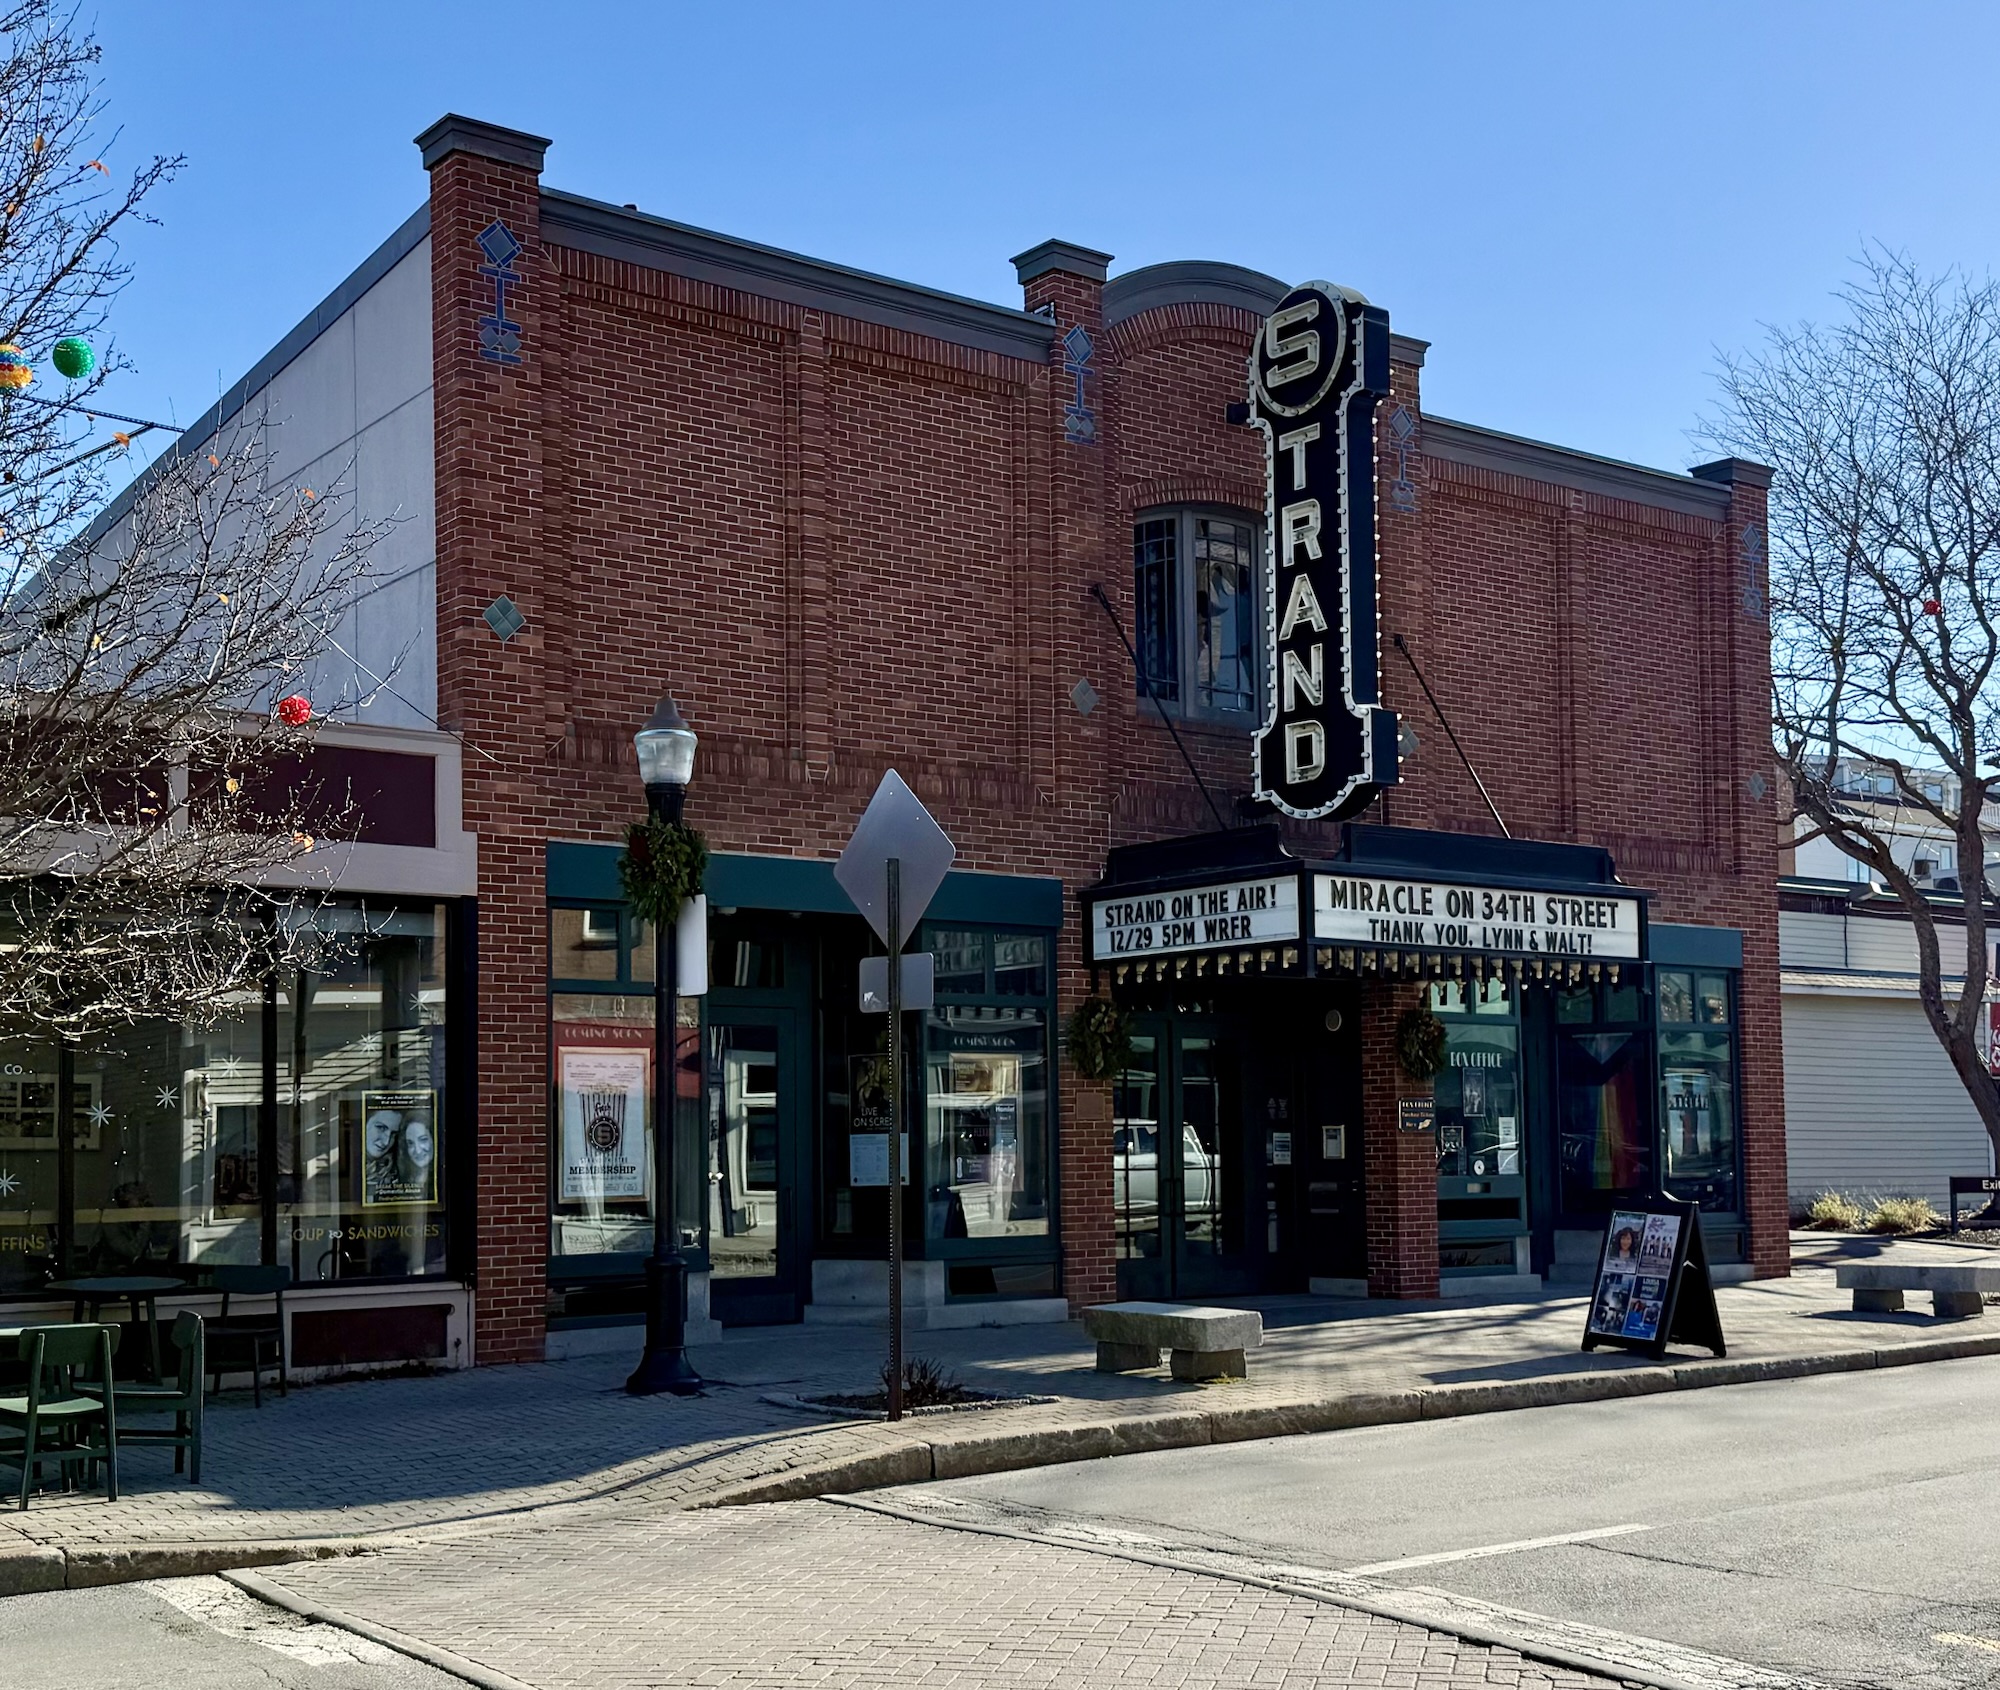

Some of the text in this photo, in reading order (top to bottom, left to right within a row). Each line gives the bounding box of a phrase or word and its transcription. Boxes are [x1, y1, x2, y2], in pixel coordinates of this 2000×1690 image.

[1266, 299, 1328, 785] STRAND
[1105, 884, 1277, 928] STRAND ON THE AIR!
[1330, 879, 1619, 929] MIRACLE ON 34TH STREET
[1110, 915, 1252, 952] 12/29 5PM WRFR
[1369, 918, 1424, 944] THANK
[1482, 926, 1524, 950] LYNN
[1529, 929, 1539, 951] &
[1545, 931, 1593, 955] WALT!
[612, 1029, 643, 1039] SOON
[1450, 1051, 1503, 1068] BOX OFFICE
[853, 1117, 890, 1127] ON SCRE
[861, 1107, 878, 1117] LIVE
[569, 1166, 637, 1175] MEMBERSHIP
